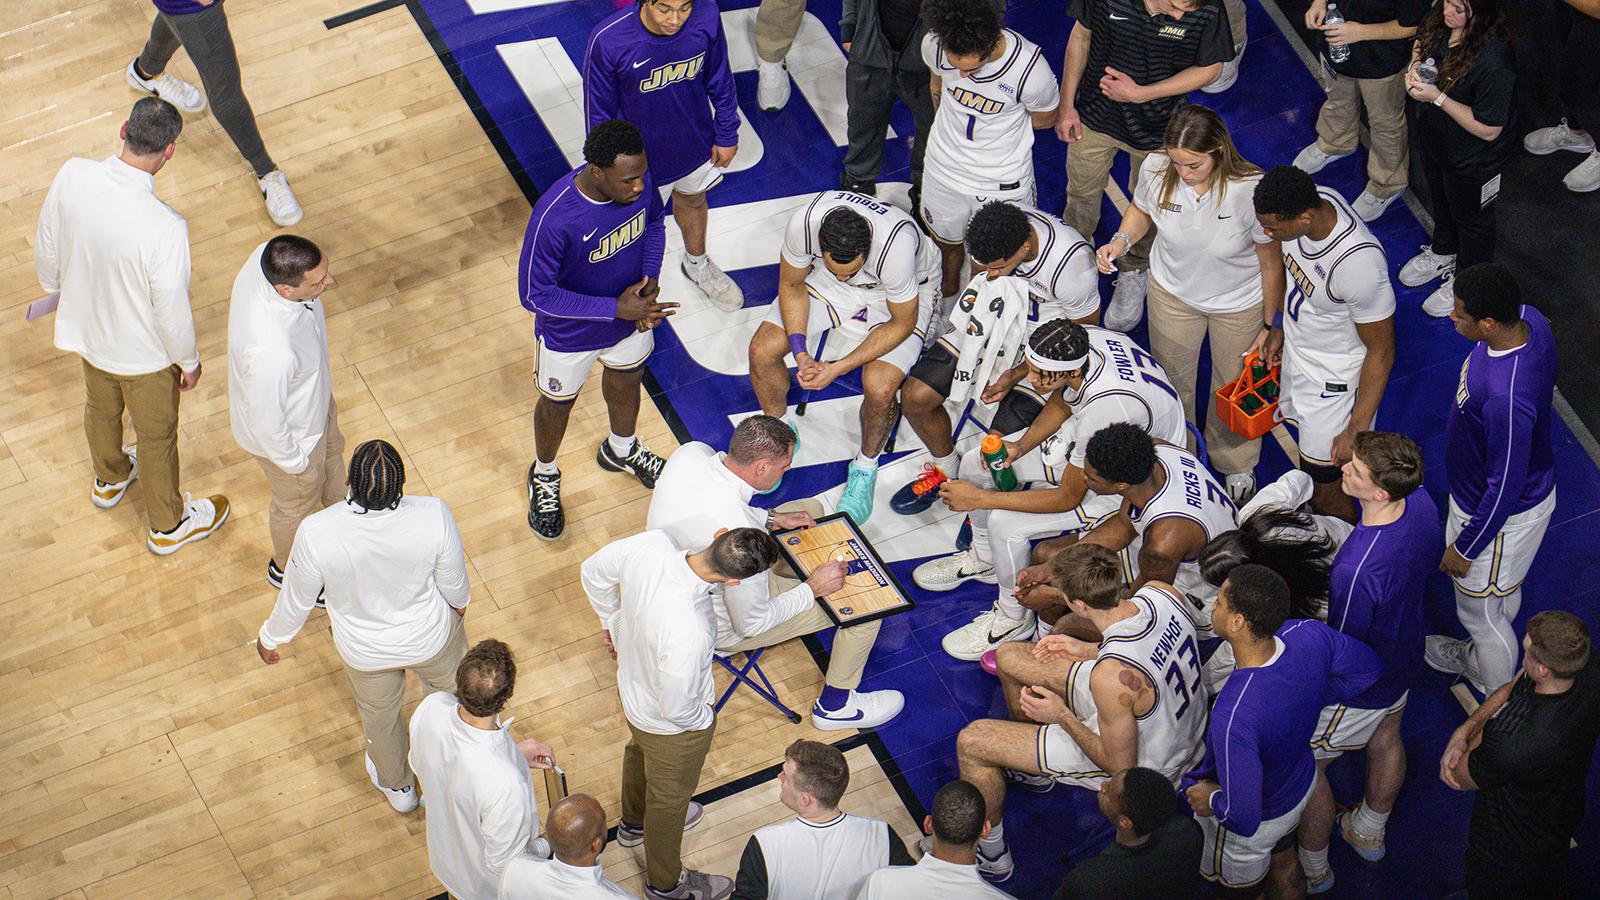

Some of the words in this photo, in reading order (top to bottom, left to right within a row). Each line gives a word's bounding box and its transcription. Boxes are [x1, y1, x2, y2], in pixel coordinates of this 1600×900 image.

[1159, 26, 1187, 36] JMU
[640, 51, 706, 93] JMU
[947, 86, 1005, 115] JMU
[966, 113, 976, 141] 1
[834, 192, 888, 216] EGBULE
[588, 208, 646, 263] JMU
[1283, 252, 1315, 298] JMU
[1106, 339, 1136, 383] FOWLER
[1130, 347, 1178, 402] 13
[1180, 456, 1196, 469] III
[1183, 470, 1202, 509] RICKS
[1205, 479, 1239, 528] 3
[849, 541, 867, 560] JAMES
[863, 560, 887, 585] MADISON
[1150, 614, 1183, 671] NEWHOF
[1165, 634, 1201, 720] 33
